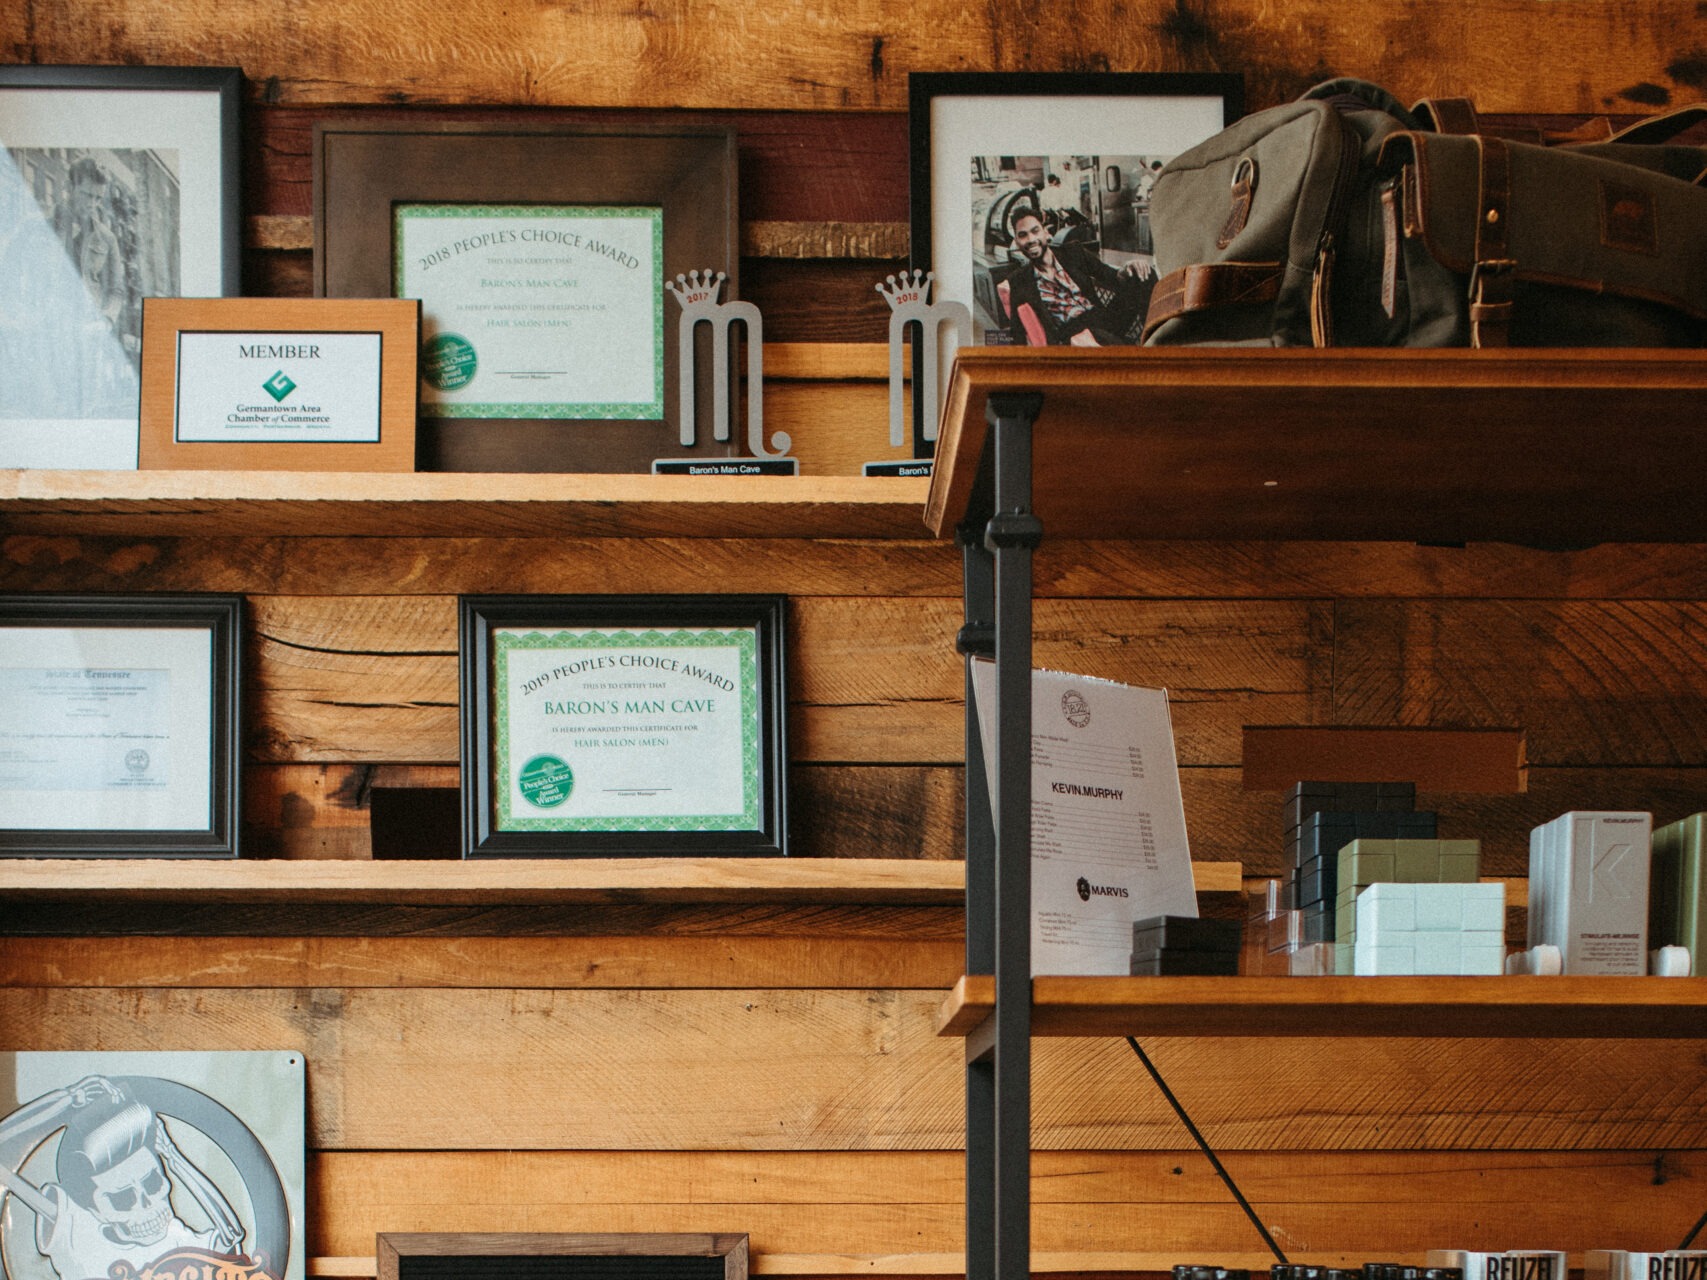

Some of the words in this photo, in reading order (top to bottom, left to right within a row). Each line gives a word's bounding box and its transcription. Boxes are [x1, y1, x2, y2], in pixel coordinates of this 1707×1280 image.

[418, 247, 451, 271] 2018
[454, 229, 516, 255] PEOPLE'S
[521, 229, 582, 248] CHOICE
[585, 239, 640, 271] AWARD
[526, 278, 550, 288] MAN
[553, 278, 578, 288] CAVE
[239, 344, 321, 359] MEMBER
[236, 403, 297, 413] Germantown
[300, 404, 322, 413] Area
[227, 413, 270, 423] Chamber
[281, 413, 331, 423] Commerce
[689, 465, 719, 475] Baron's
[721, 465, 738, 474] Man
[740, 465, 761, 473] Cave
[899, 466, 929, 476] Baron's
[520, 674, 550, 696] 2019
[553, 656, 615, 680] PEOPLE'S
[619, 655, 679, 671] CHOICE
[681, 664, 735, 692] AWARD
[544, 701, 619, 715] BARON'S
[624, 700, 665, 714] MAN
[671, 699, 715, 713] CAVE
[574, 739, 600, 748] HAIR
[603, 738, 636, 747] SALON
[1051, 782, 1123, 800] KEVIN.MURPHY
[1091, 885, 1129, 898] MARVIS
